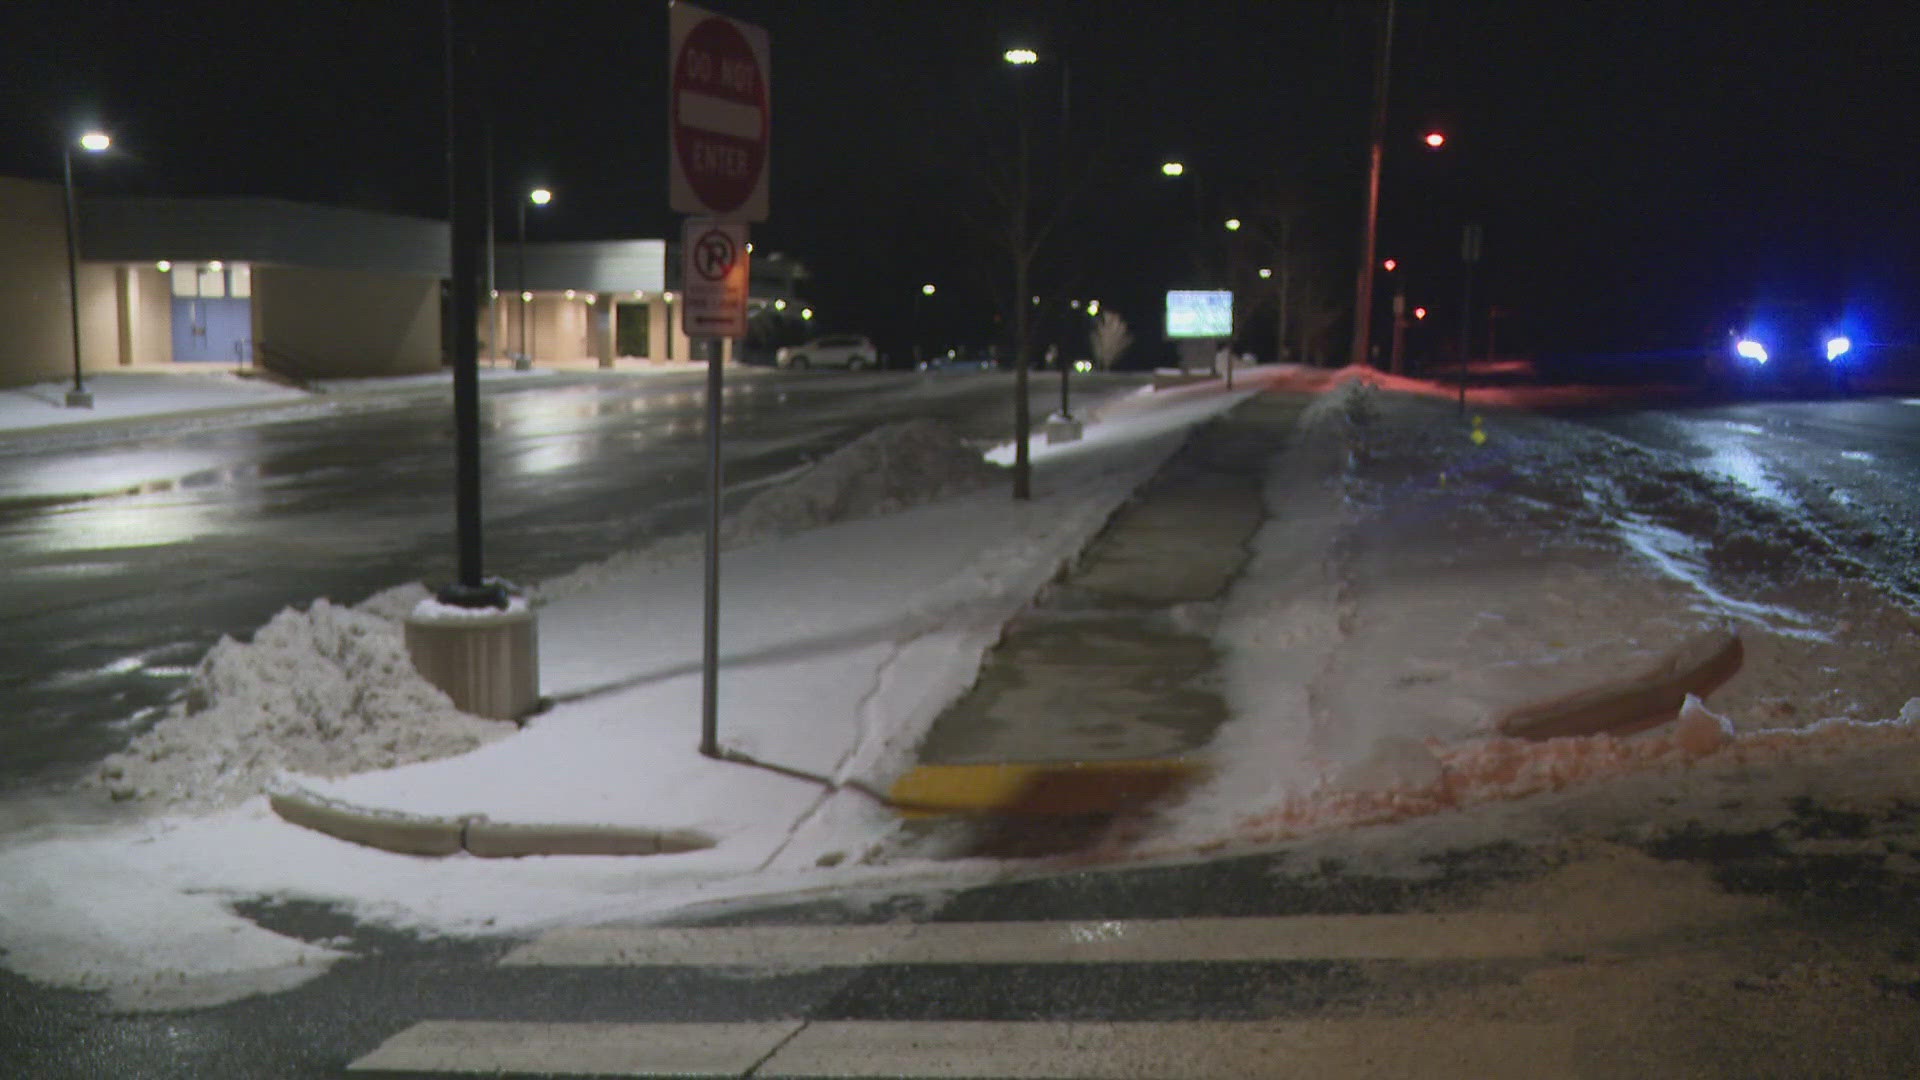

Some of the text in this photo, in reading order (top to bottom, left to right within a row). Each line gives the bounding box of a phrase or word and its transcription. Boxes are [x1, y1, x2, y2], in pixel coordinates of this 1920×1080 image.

[685, 48, 755, 93] DO NOT
[692, 140, 749, 177] ENTER
